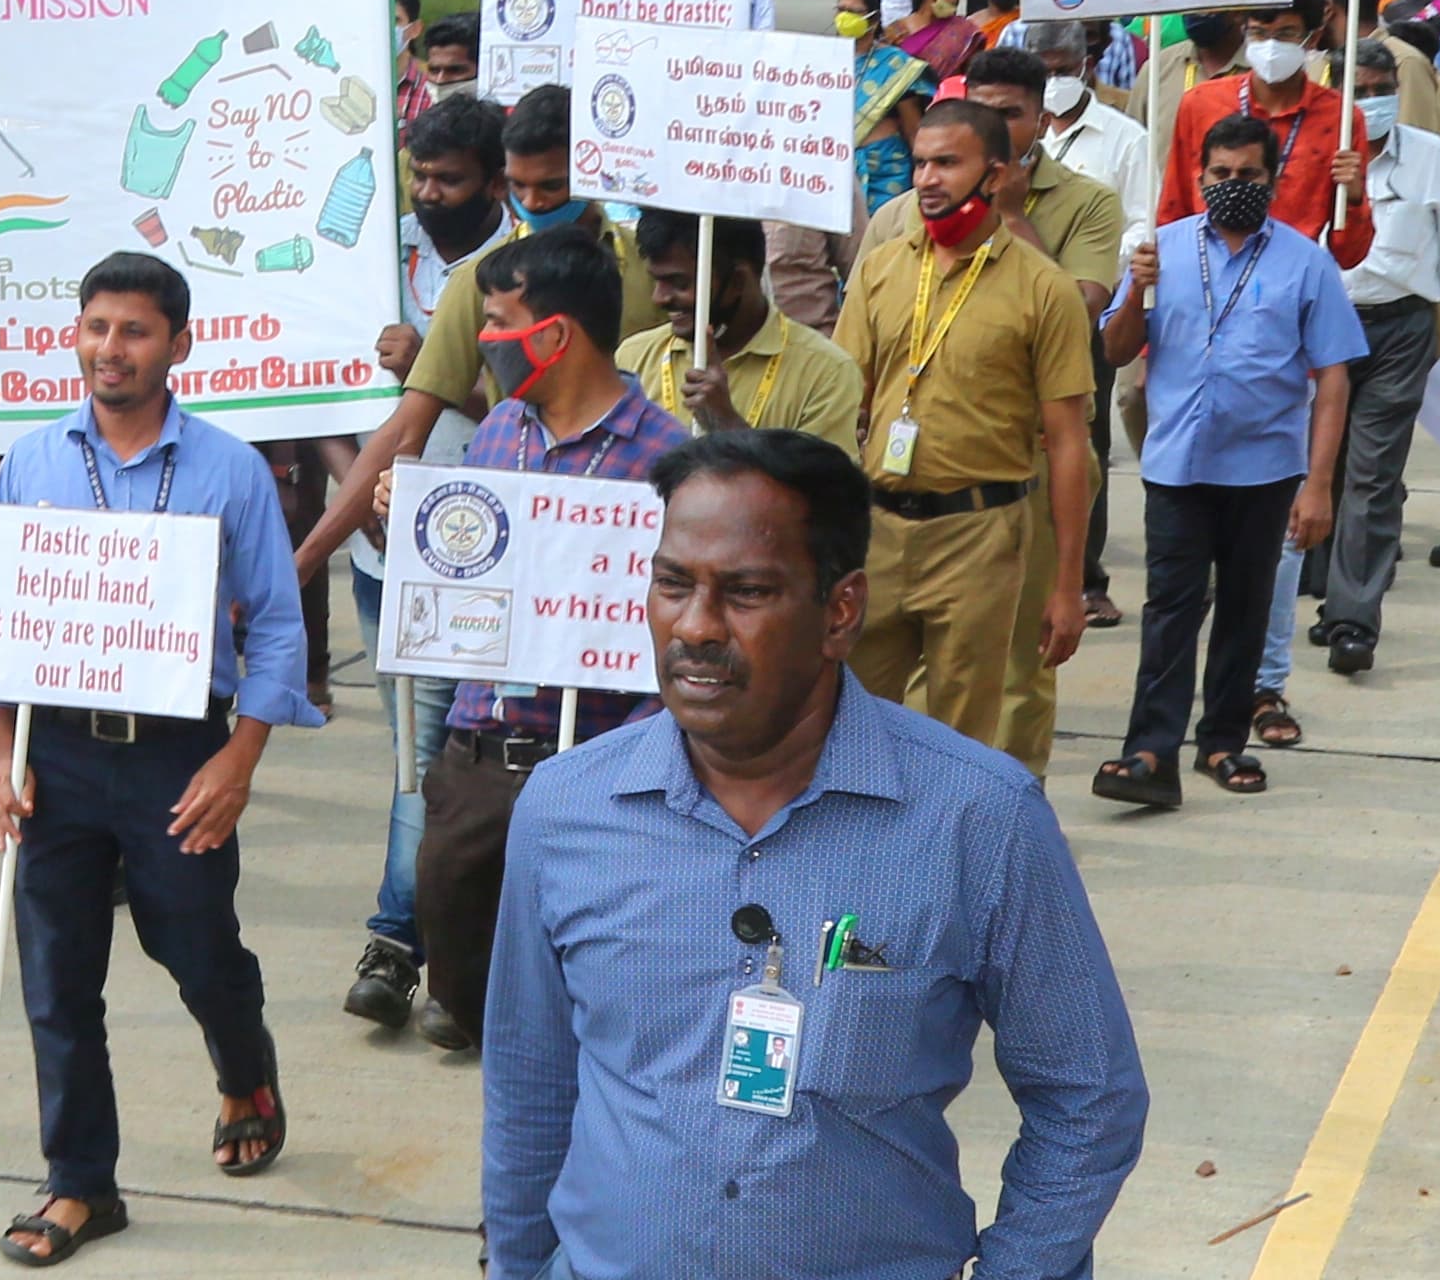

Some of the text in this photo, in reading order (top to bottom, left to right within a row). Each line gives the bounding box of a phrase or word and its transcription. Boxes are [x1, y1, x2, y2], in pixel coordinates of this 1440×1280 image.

[666, 55, 743, 81] பூமியை
[207, 89, 313, 139] Say NO
[696, 91, 746, 117] பூதம்
[667, 119, 775, 151] பிளாஸ்டிக்
[247, 139, 276, 169] to
[213, 178, 307, 220] Plastic
[530, 494, 658, 530] Plastic
[19, 522, 160, 562] Plastic give a
[590, 553, 609, 575] a
[15, 564, 156, 611] helpful hand,
[533, 594, 647, 625] which
[10, 613, 57, 651] they
[62, 622, 95, 647] are
[102, 620, 201, 663] polluting
[579, 646, 641, 671] our
[35, 658, 124, 695] our land
